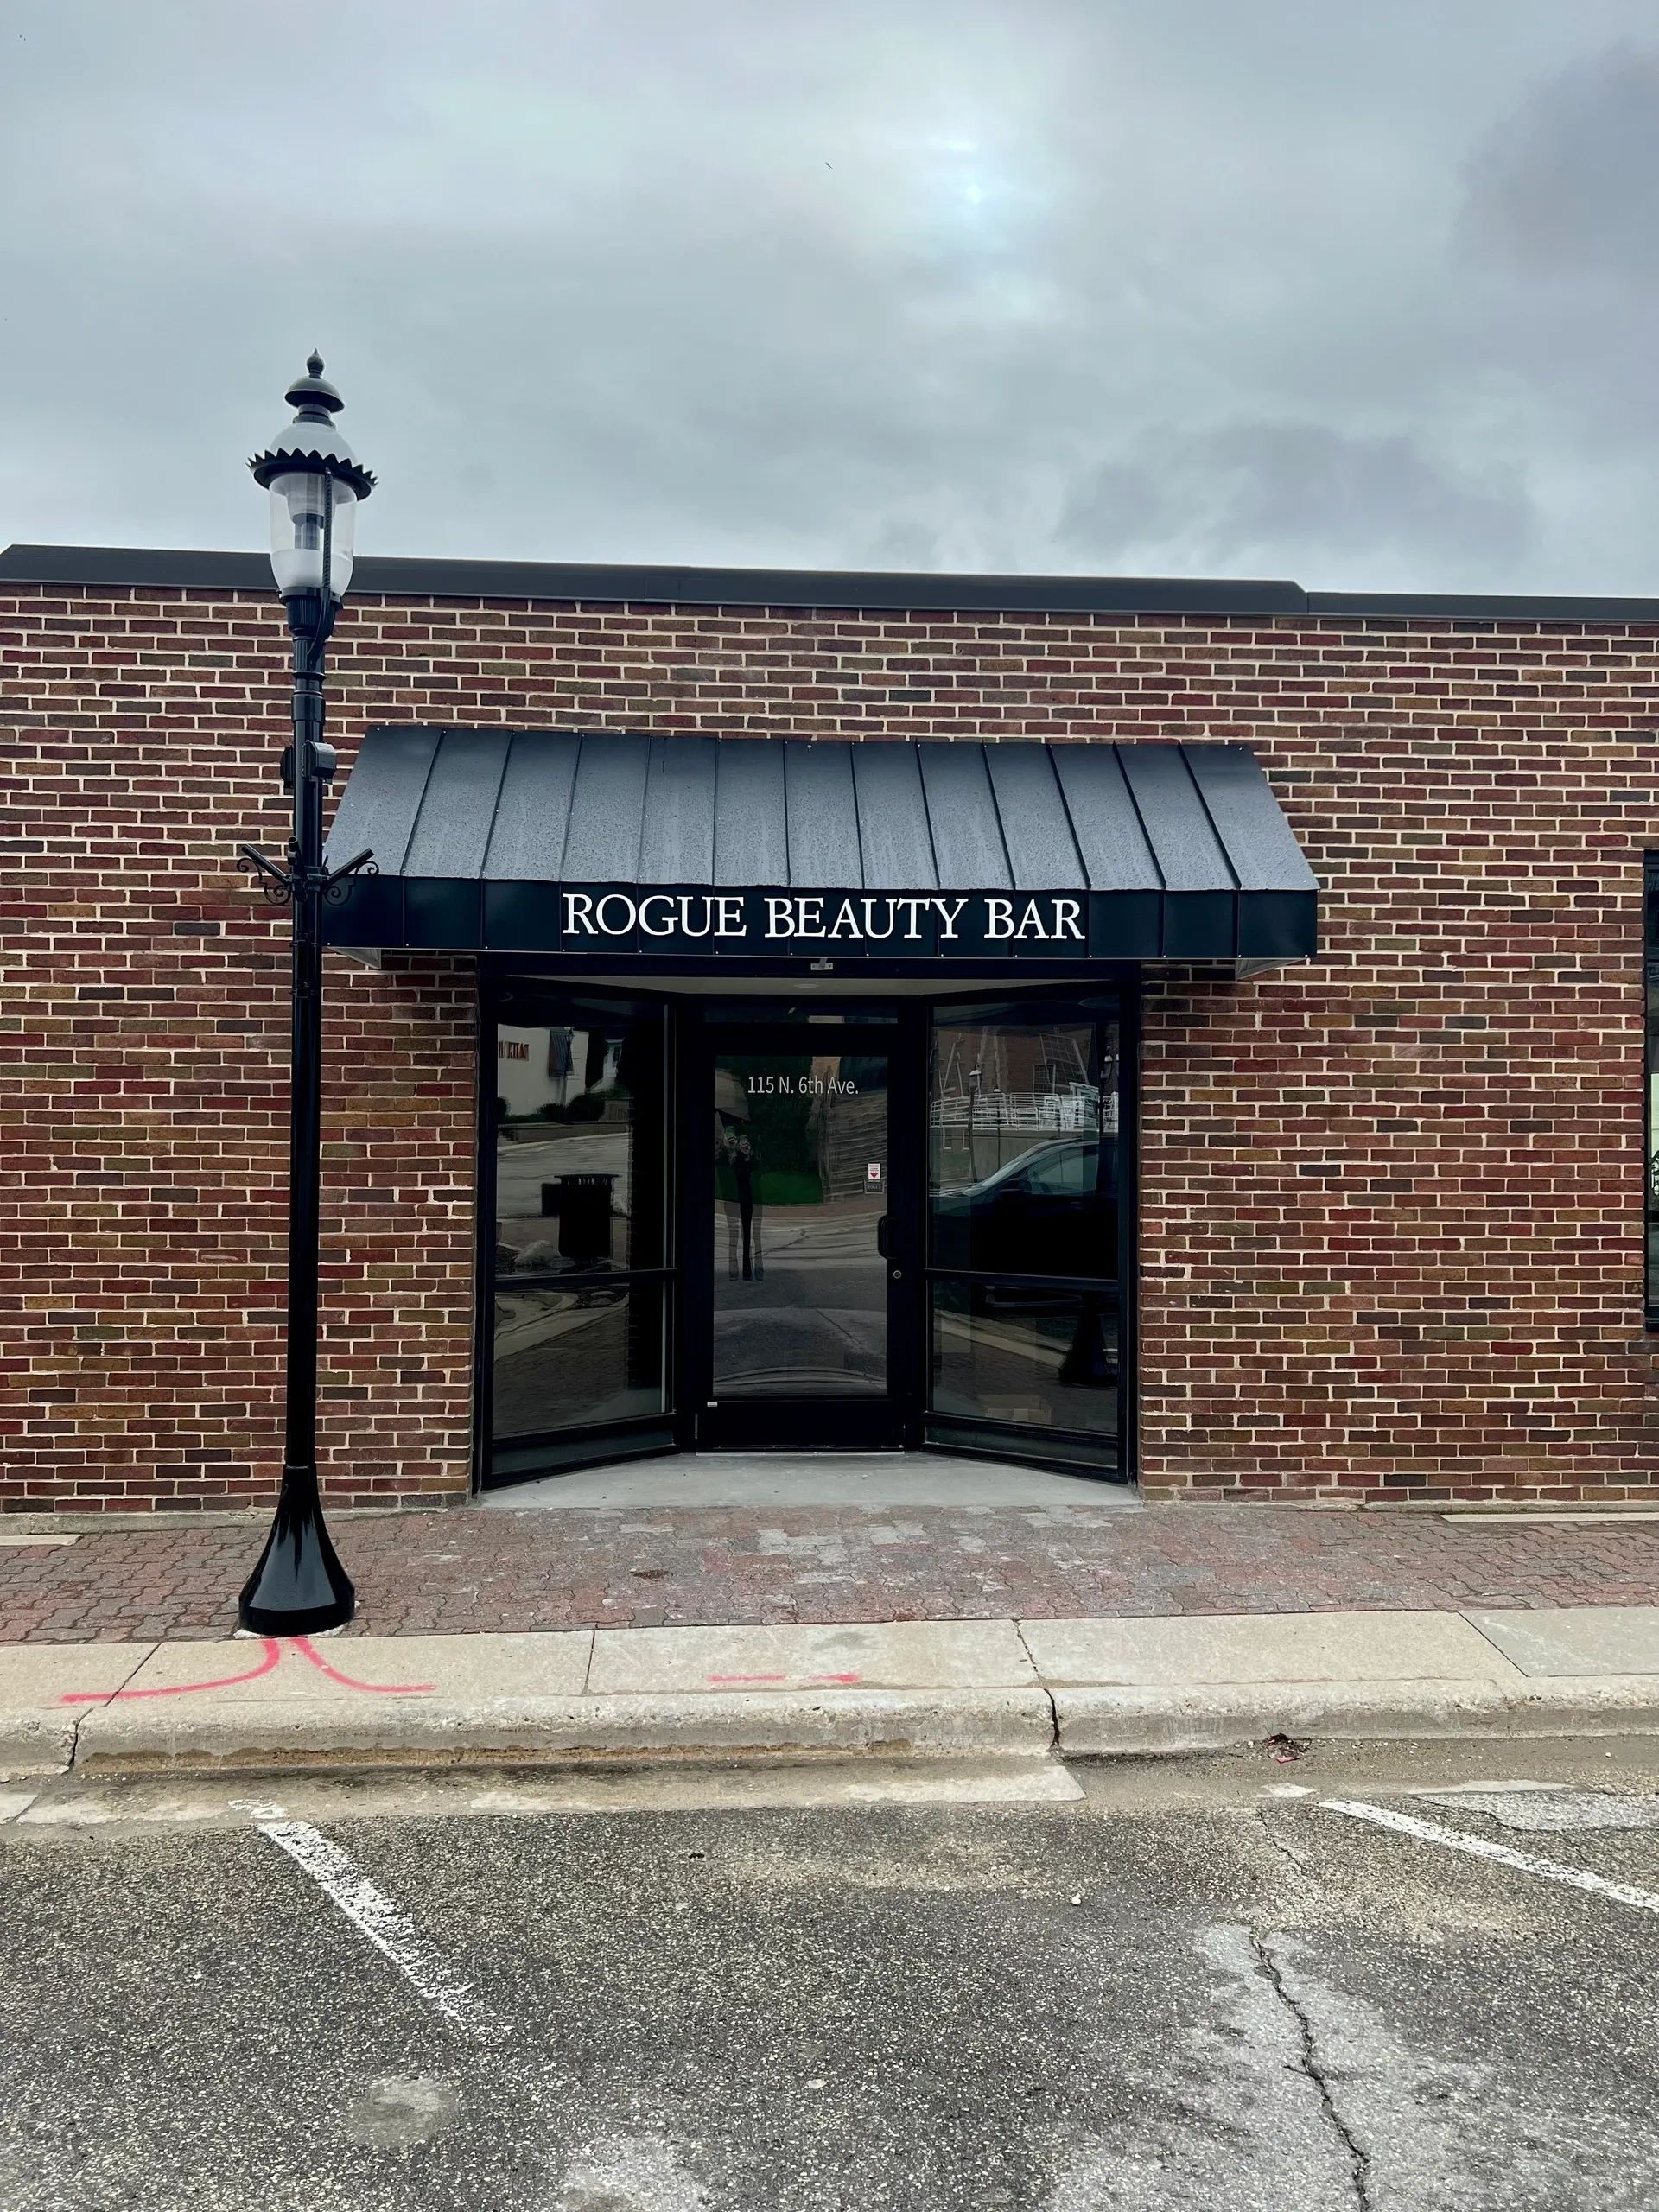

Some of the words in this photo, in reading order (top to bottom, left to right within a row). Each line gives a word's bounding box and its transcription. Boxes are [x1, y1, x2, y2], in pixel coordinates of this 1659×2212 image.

[562, 893, 747, 938] ROGUE
[764, 897, 969, 939] BEAUTY
[983, 899, 1086, 940] BAR
[747, 1076, 774, 1094] 115
[779, 1076, 794, 1094] N.
[798, 1076, 823, 1094] 6th
[827, 1077, 859, 1095] Ave.
